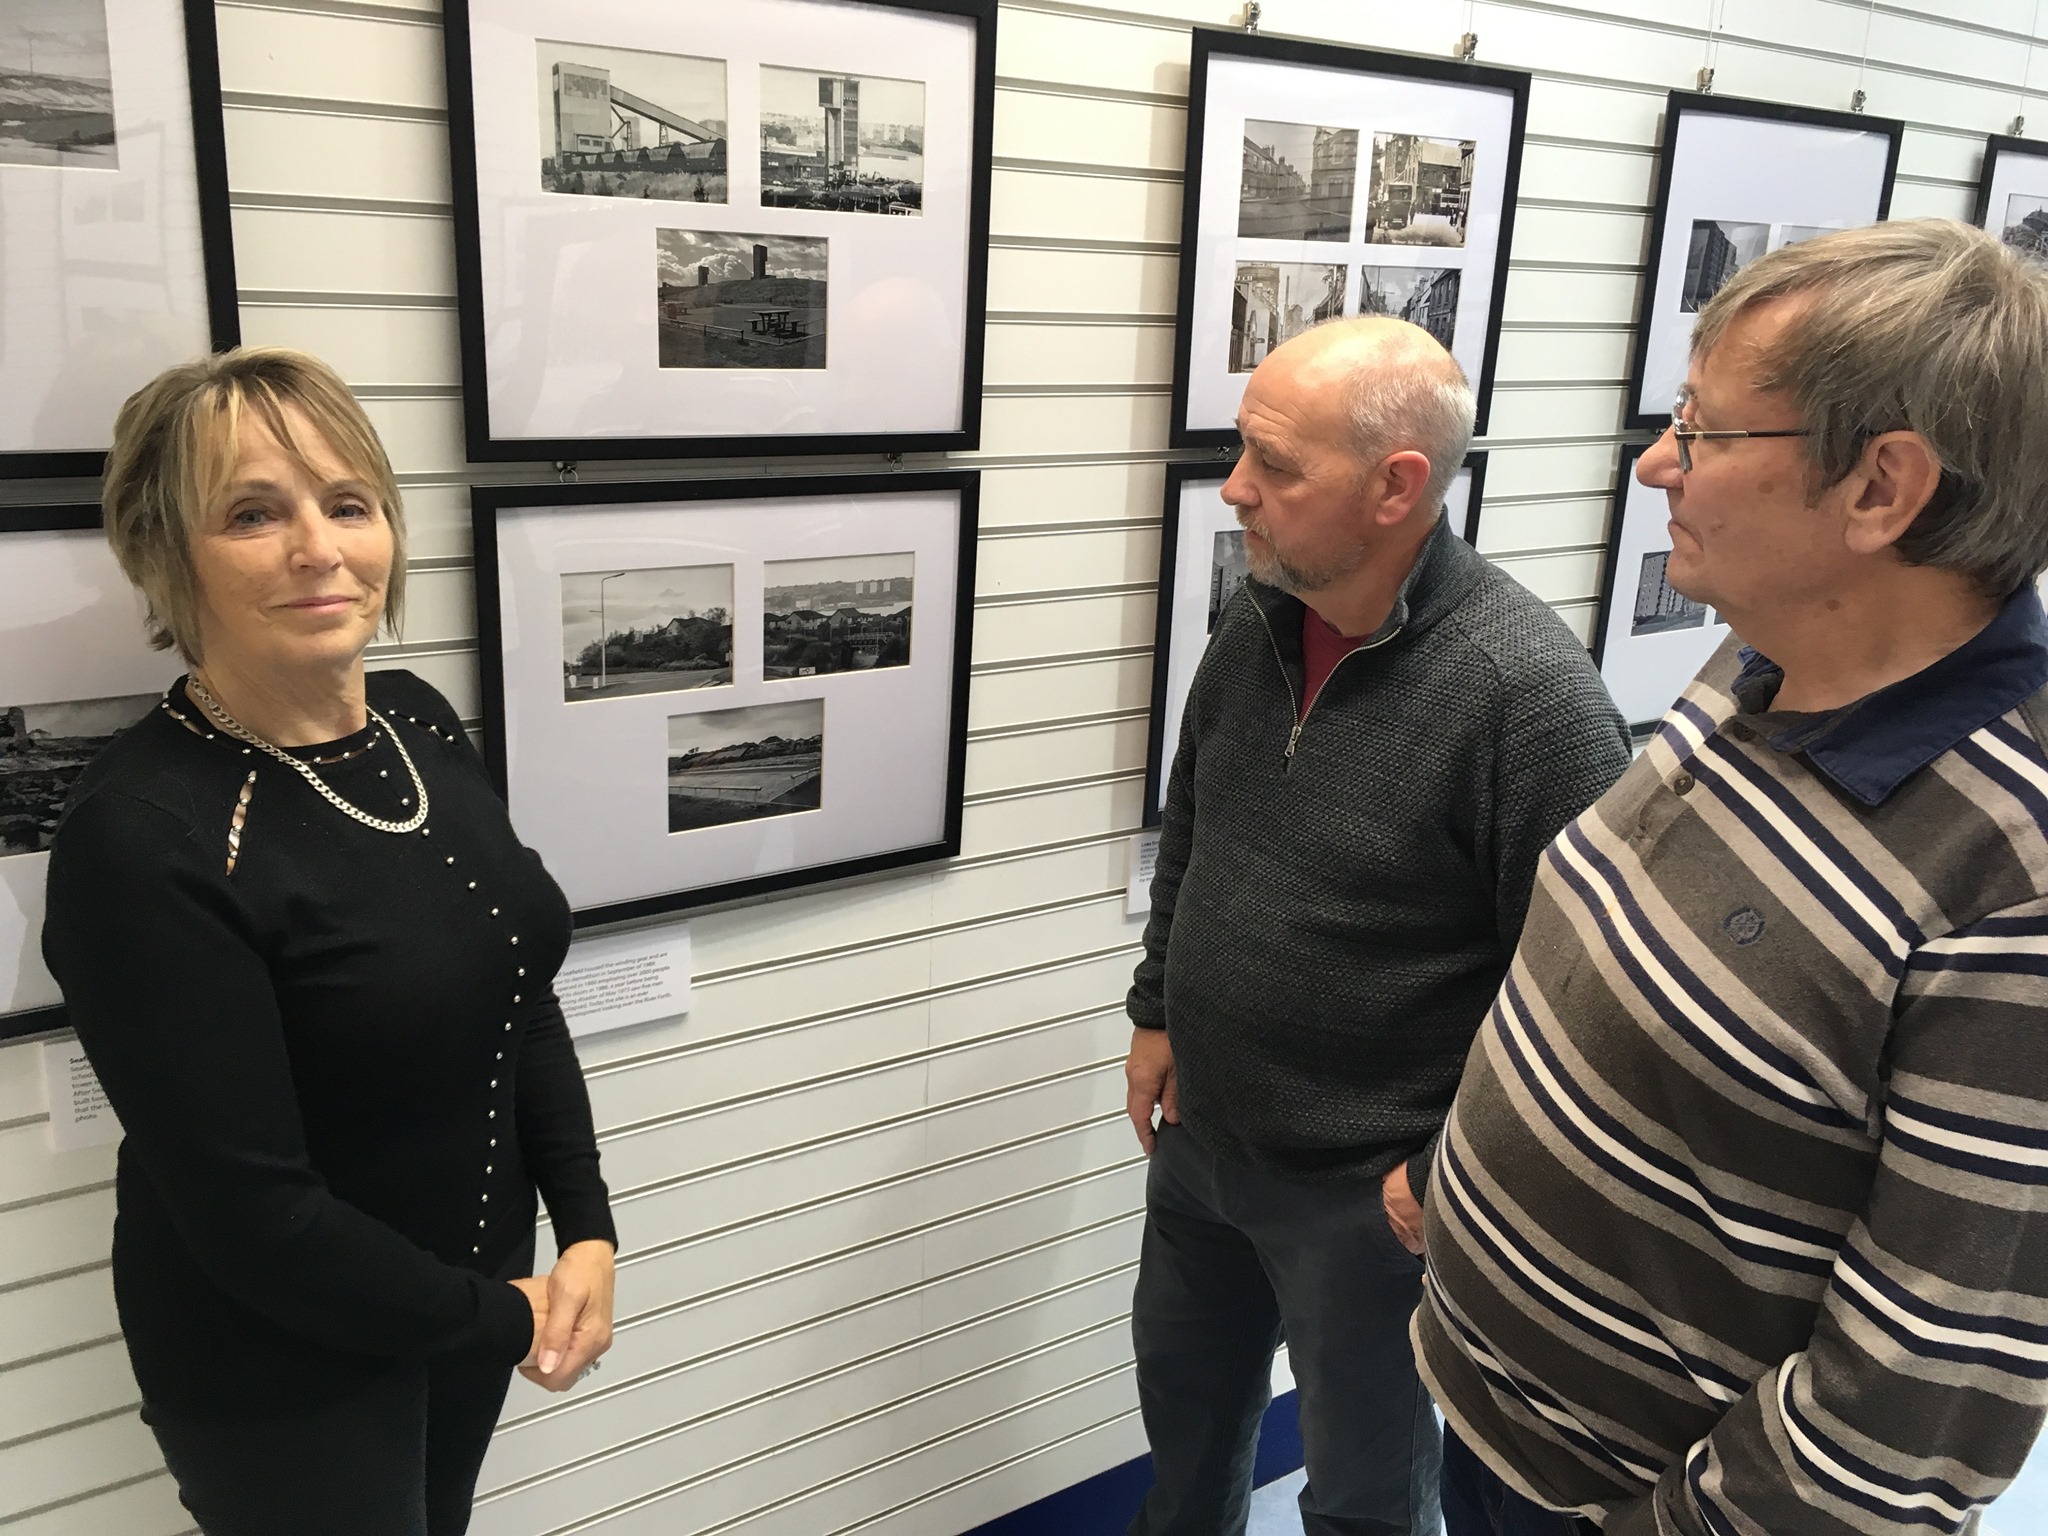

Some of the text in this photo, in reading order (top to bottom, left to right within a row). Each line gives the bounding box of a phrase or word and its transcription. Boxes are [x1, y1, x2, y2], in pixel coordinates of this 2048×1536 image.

[562, 968, 583, 976] Seafield
[614, 957, 635, 967] winding
[570, 972, 599, 982] demolition
[606, 965, 635, 975] September
[643, 974, 658, 982] being
[555, 984, 577, 992] opened
[597, 974, 625, 984] employing
[577, 994, 598, 1002] disaster
[588, 999, 604, 1007] Today
[601, 1003, 621, 1011] looking
